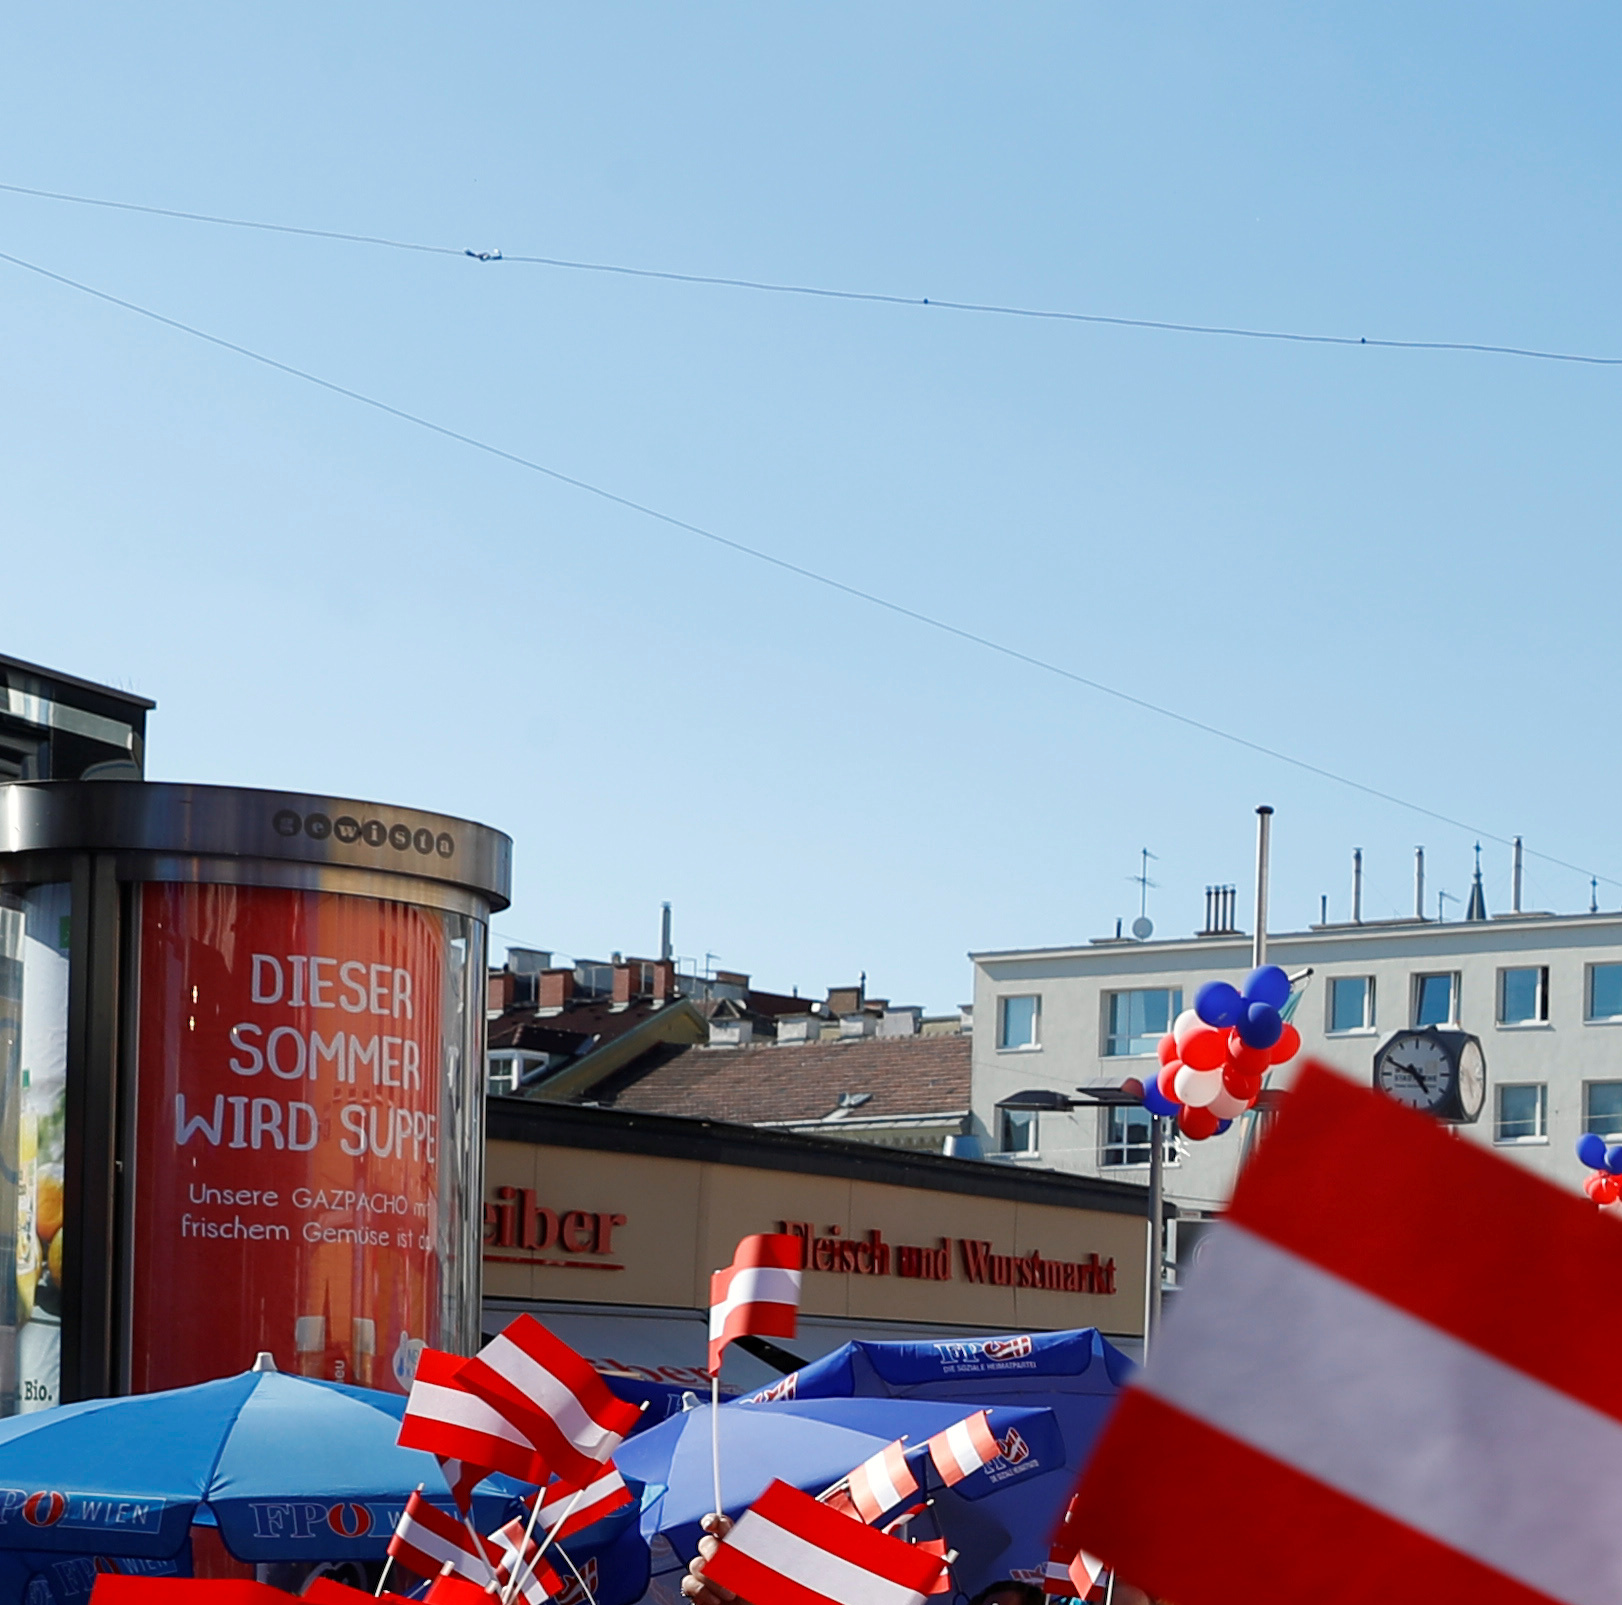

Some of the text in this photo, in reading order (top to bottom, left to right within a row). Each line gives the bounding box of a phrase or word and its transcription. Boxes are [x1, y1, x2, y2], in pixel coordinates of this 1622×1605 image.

[251, 953, 413, 1019] DIESER
[229, 1021, 422, 1092] SOMMER
[175, 1093, 438, 1164] WIRD SUPPE
[189, 1183, 279, 1208] Unsere
[292, 1187, 408, 1216] GAZPACHO
[181, 1213, 290, 1241] frischem
[302, 1220, 390, 1248] Gemüse
[397, 1228, 413, 1250] ist
[896, 1237, 951, 1281] und
[958, 1238, 1117, 1295] Wurstmarkt
[82, 1501, 149, 1526] WIEN
